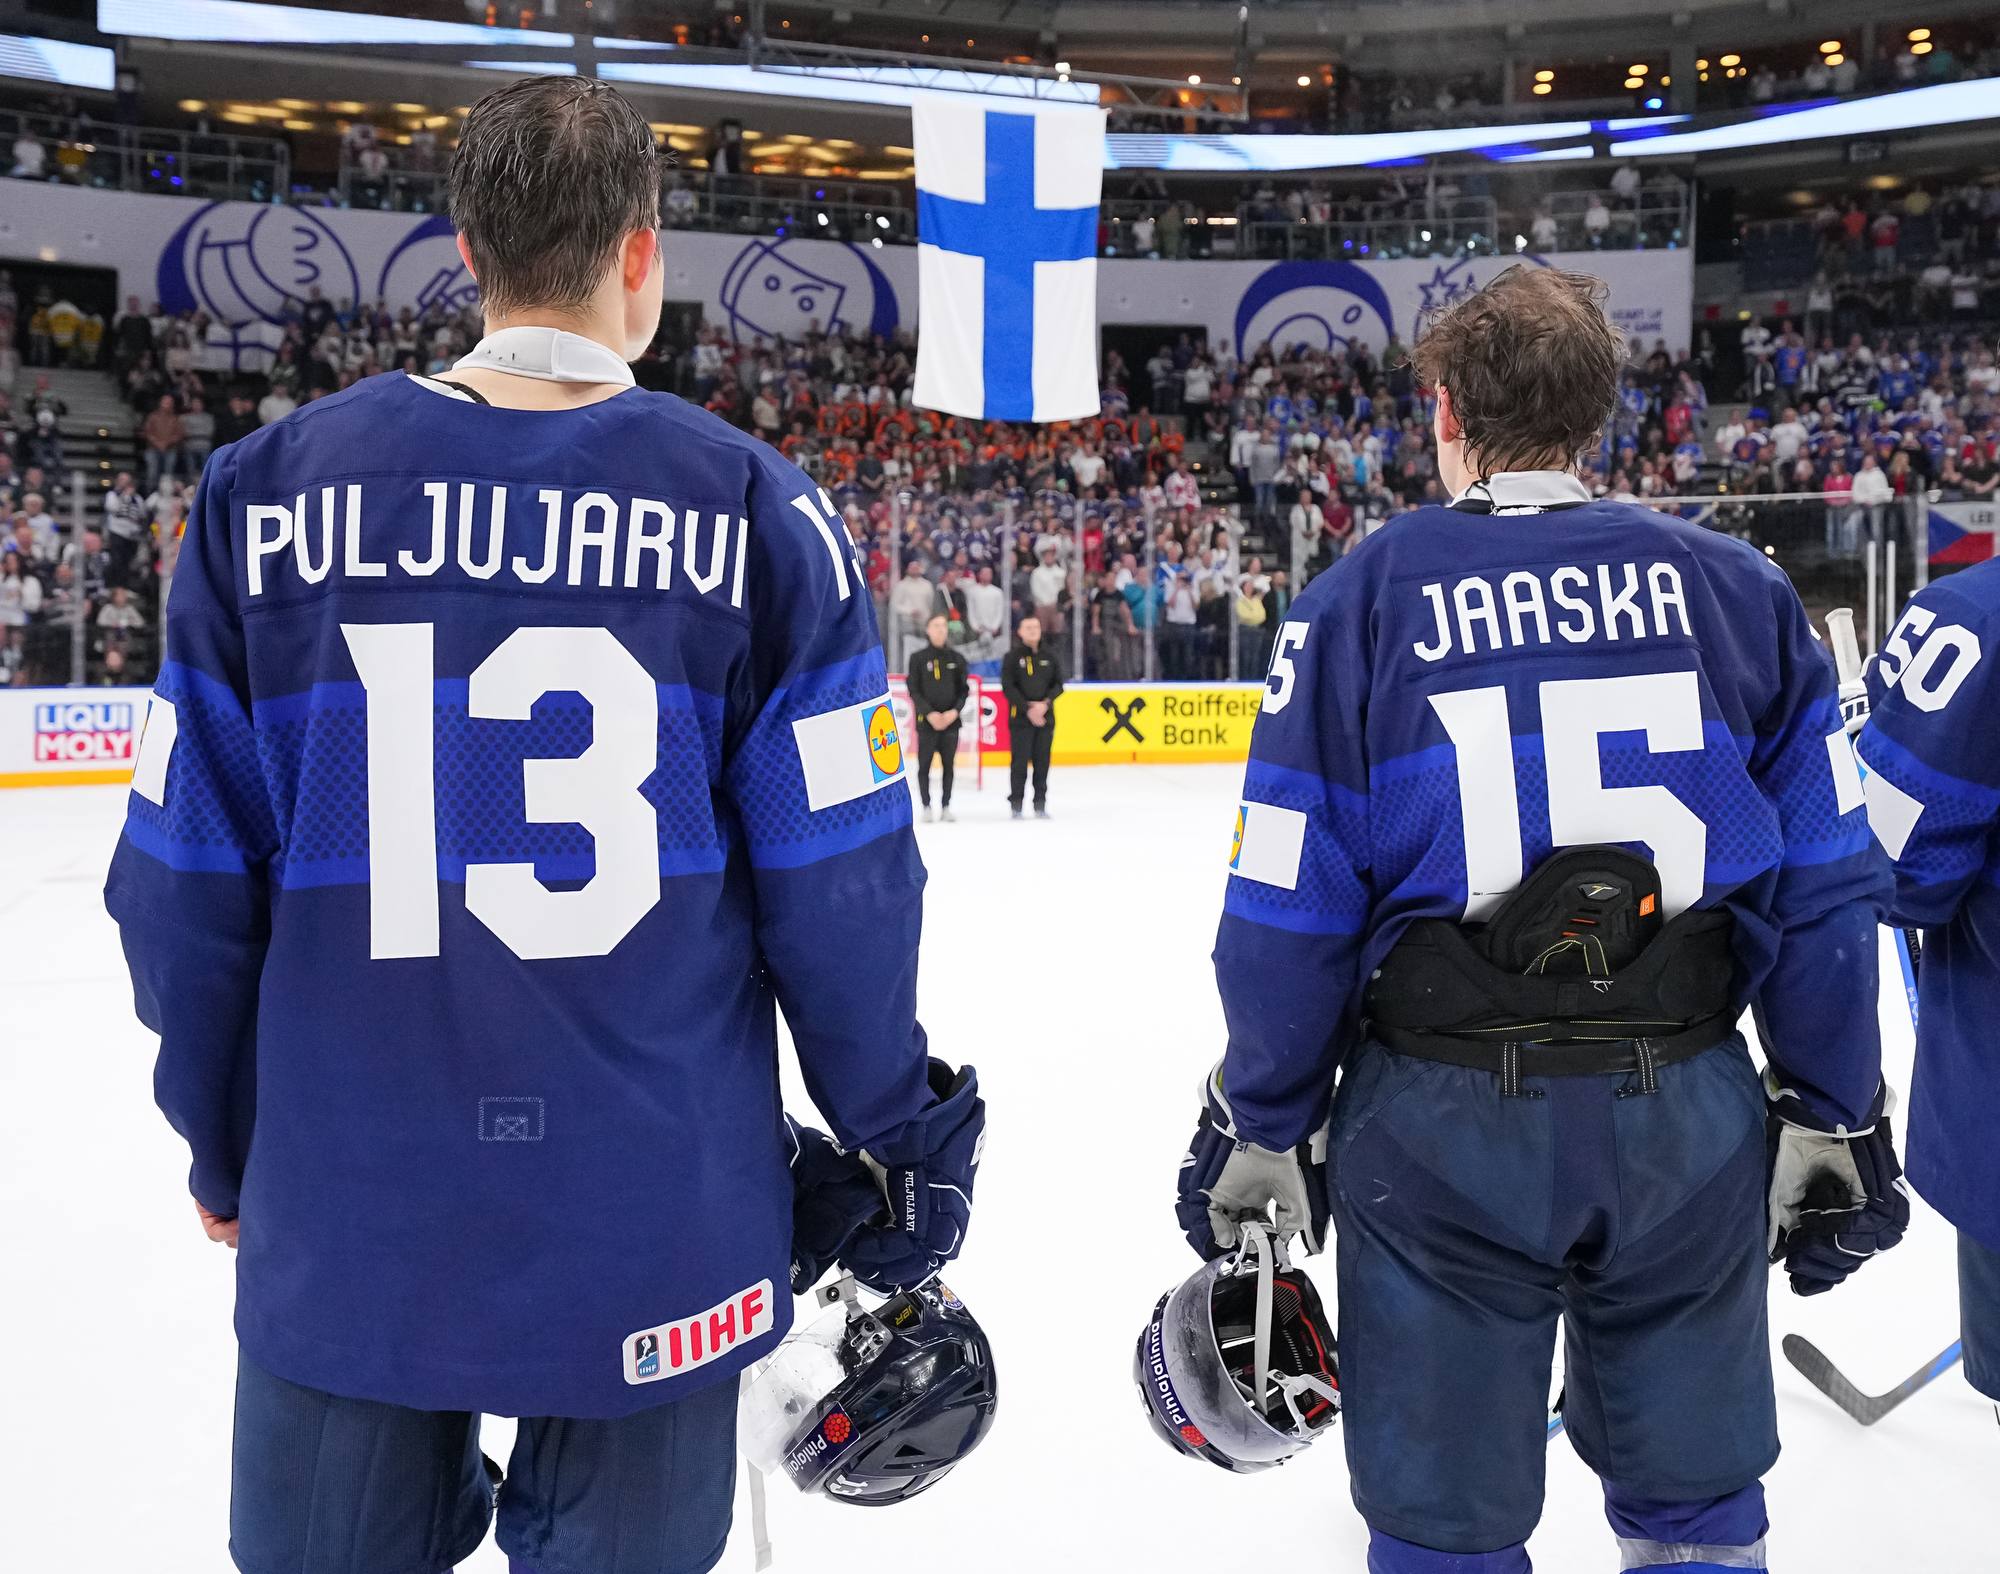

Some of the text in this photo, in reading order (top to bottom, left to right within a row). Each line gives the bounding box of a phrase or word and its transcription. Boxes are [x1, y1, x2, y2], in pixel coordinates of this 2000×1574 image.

[246, 482, 749, 609] PULJUJARVI
[1413, 562, 1693, 662] JAASKA
[1879, 604, 1982, 713] 50
[1261, 621, 1311, 715] 5
[38, 704, 130, 732] LIQUI
[38, 732, 130, 760] MOLY
[1164, 723, 1228, 745] Bank
[339, 622, 661, 960] 13
[1427, 670, 1707, 924] 15
[905, 1170, 915, 1232] PULJUJARVI
[639, 1364, 657, 1375] IIHF
[668, 1288, 763, 1368] IIHF
[1150, 1321, 1187, 1425] Pihlajalinna
